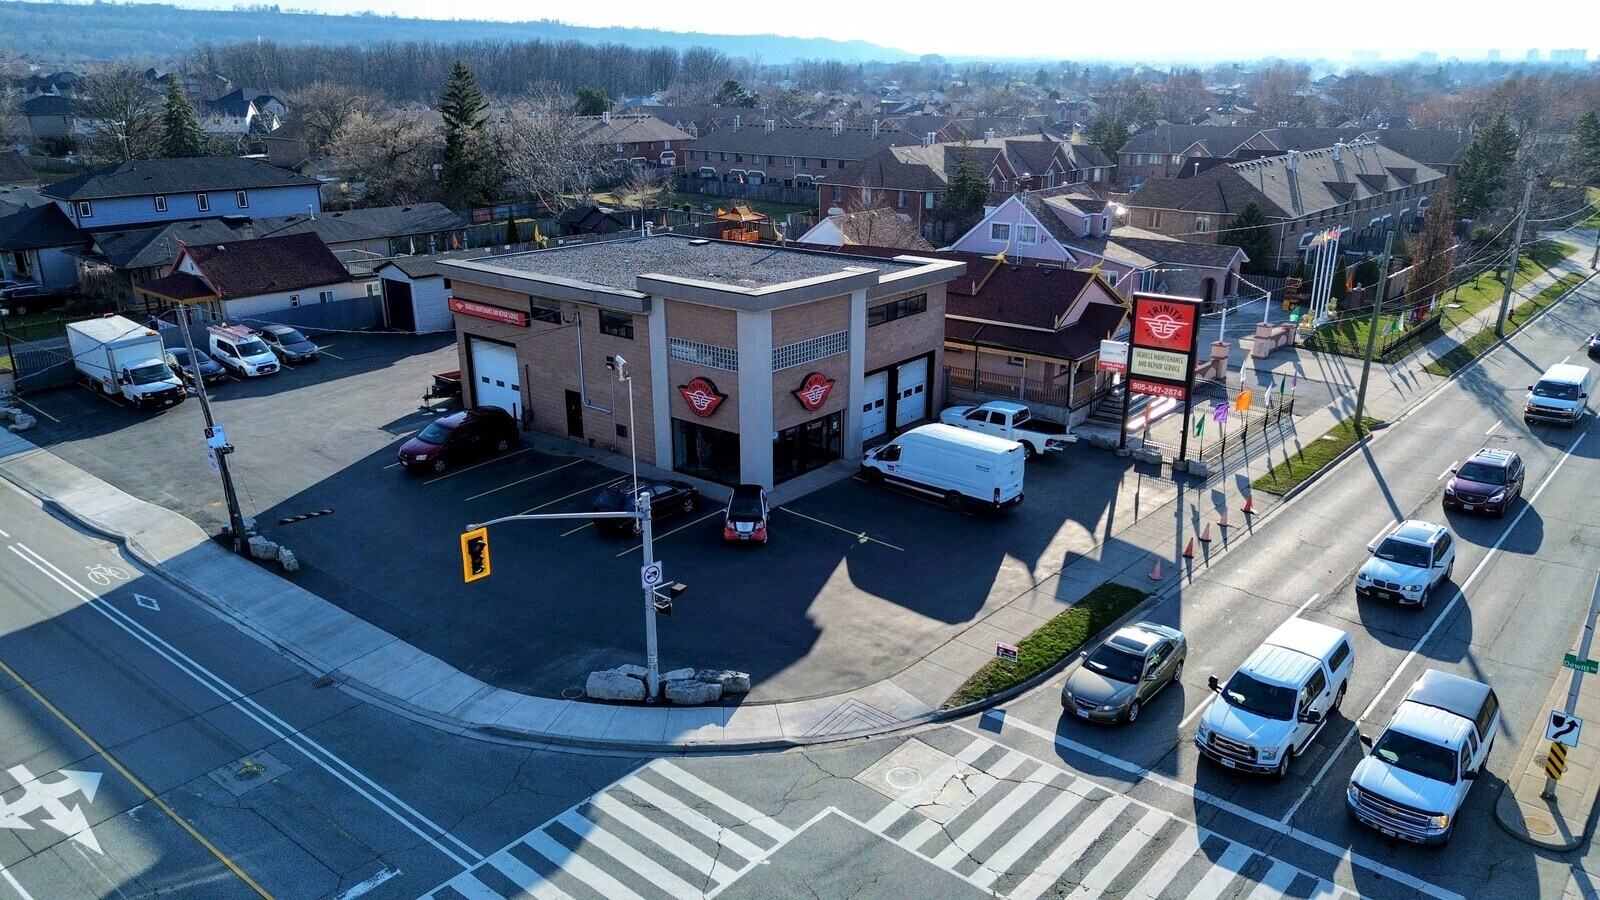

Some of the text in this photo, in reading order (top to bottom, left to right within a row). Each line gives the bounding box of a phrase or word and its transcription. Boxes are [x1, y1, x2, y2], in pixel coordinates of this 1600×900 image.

[1147, 304, 1183, 321] TRINITY
[1136, 351, 1184, 365] VEHICLE MAINTENANCE
[1138, 360, 1148, 368] AND
[1147, 361, 1163, 371] REPAIR
[1163, 363, 1181, 373] SERVICE
[690, 382, 713, 396] TRINITY
[806, 377, 825, 390] TRINITY
[1132, 382, 1182, 397] 905-547-2874
[1564, 660, 1589, 672] Dewitt
